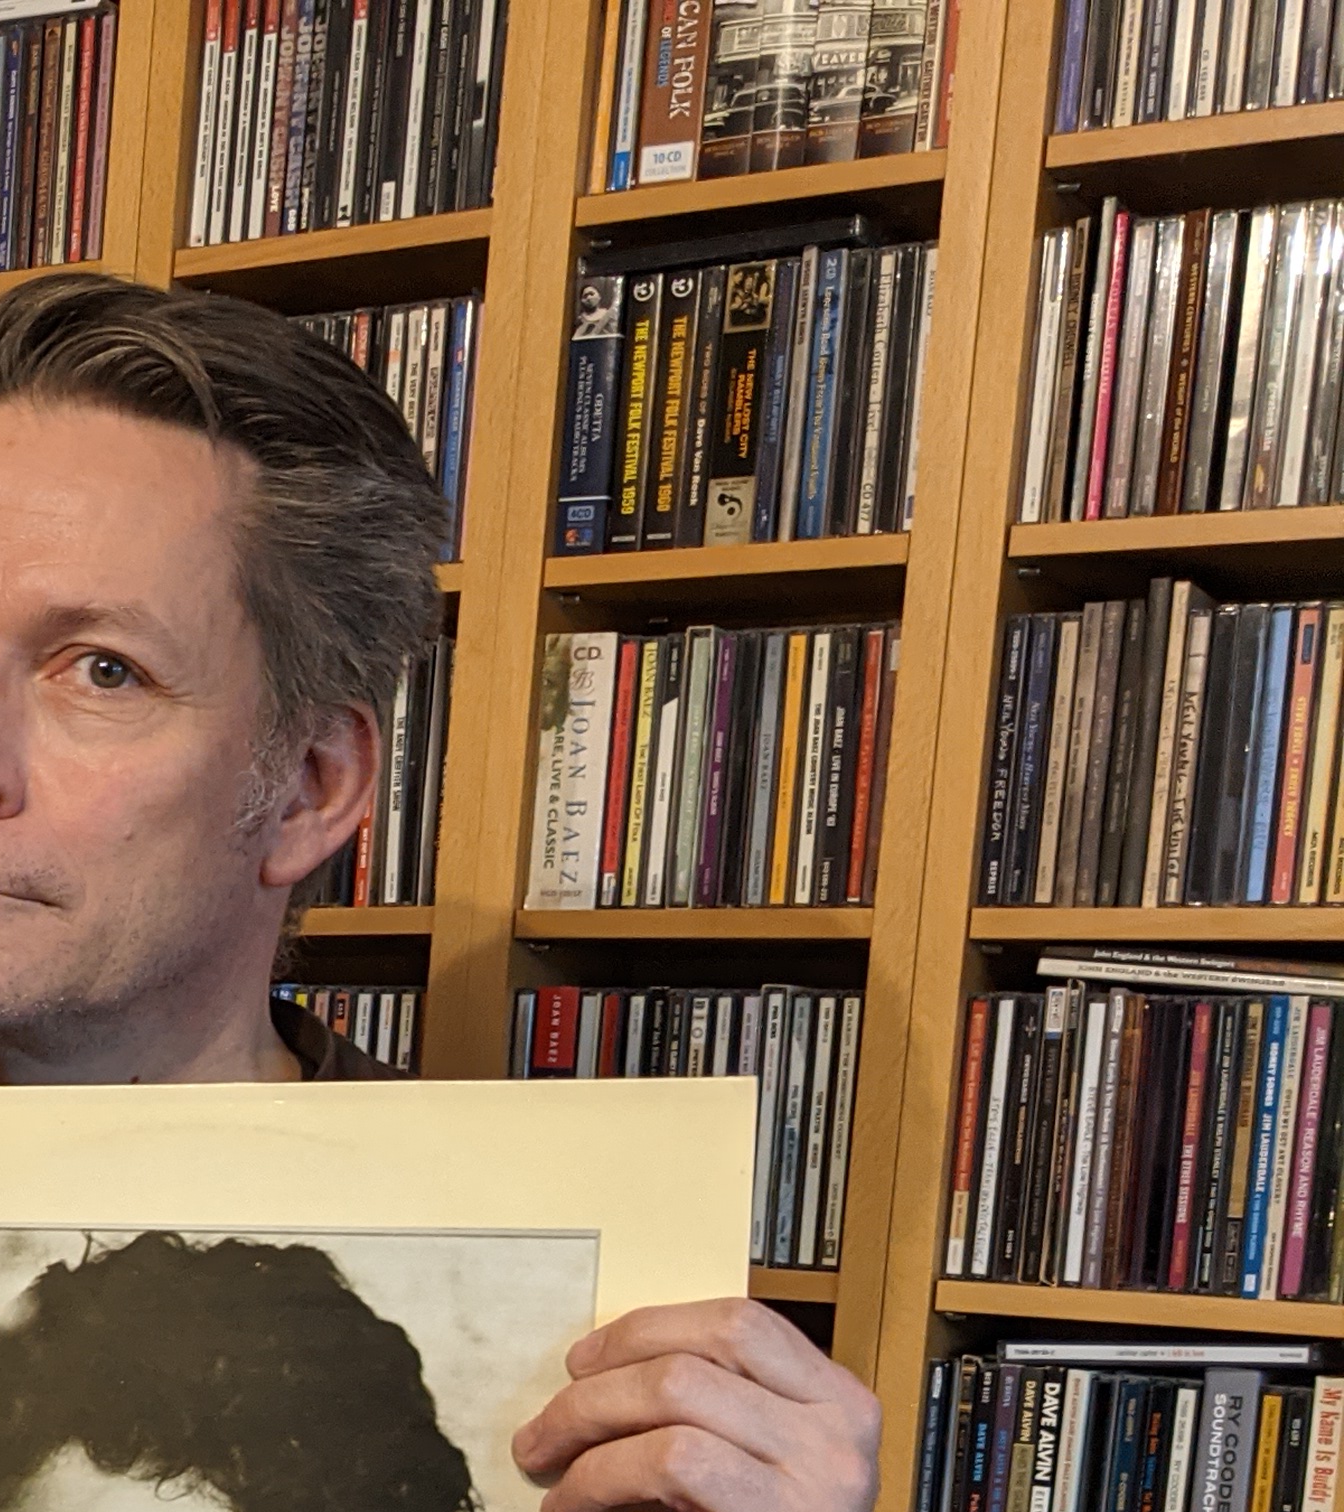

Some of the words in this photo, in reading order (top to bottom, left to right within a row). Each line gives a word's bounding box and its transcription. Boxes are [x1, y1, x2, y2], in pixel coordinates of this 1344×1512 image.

[273, 26, 296, 122] JOHNNY
[291, 16, 313, 127] JOHNNY
[669, 56, 696, 120] FOLK
[283, 134, 305, 208] CASH
[269, 185, 280, 213] LOVE
[287, 209, 297, 231] GOD
[1067, 272, 1081, 314] RODNEY
[1188, 263, 1201, 303] WESTERN
[875, 273, 893, 335] Elizabeth
[635, 319, 650, 342] THE
[672, 315, 688, 339] THE
[1181, 305, 1195, 353] CENTURIES
[667, 341, 687, 395] NEWPORT
[702, 343, 714, 368] TWO
[745, 349, 758, 371] THE
[870, 339, 888, 384] Cotten
[629, 345, 649, 399] NEWPORT
[742, 374, 754, 401] NEW
[591, 393, 605, 442] ODETTA
[626, 402, 644, 428] FOLK
[663, 400, 682, 427] FOLK
[732, 373, 746, 436] RAMBLERS
[740, 403, 753, 431] LOST
[865, 400, 882, 432] Live!
[694, 418, 707, 447] Dave
[737, 433, 748, 458] CITY
[1169, 431, 1181, 463] WORLD
[622, 432, 641, 482] FESTIVAL
[658, 430, 679, 480] FESTIVAL
[691, 451, 703, 473] Van
[619, 485, 637, 515] 1959
[688, 474, 702, 506] Ronk
[862, 483, 874, 500] CD
[644, 649, 657, 683] JOAN
[641, 686, 654, 719] BAEZ
[835, 707, 846, 727] JOAN
[568, 699, 596, 780] JOAN
[833, 728, 844, 749] BAEZ
[550, 759, 565, 791] LIVE
[830, 754, 842, 771] LIVE
[548, 794, 560, 804] &
[990, 767, 1008, 842] FREEDOM
[543, 808, 559, 869] CLASSIC
[805, 811, 817, 835] ALBUM
[559, 800, 587, 885] BAEZ
[987, 860, 999, 895] REPRISE
[1306, 851, 1318, 887] RECORDS
[551, 994, 561, 1027] JOAN
[771, 1005, 779, 1020] PHIL
[548, 1031, 559, 1063] BAEZ
[1314, 1026, 1326, 1046] JIM
[1222, 1054, 1232, 1068] JIM
[1085, 1086, 1097, 1112] STEVE
[1216, 1069, 1230, 1114] LAUDERDALE
[1305, 1048, 1324, 1119] LAUDERDALE
[813, 1107, 823, 1134] PAXTON
[1213, 1123, 1225, 1147] RALPH
[1261, 1112, 1273, 1131] JIM
[1181, 1144, 1195, 1159] THE
[1211, 1148, 1222, 1179] STANLEY
[1255, 1132, 1272, 1193] LAUDERDALE
[1299, 1127, 1315, 1171] REASON
[1079, 1164, 1090, 1182] Low
[1179, 1159, 1193, 1185] OTHER
[1296, 1173, 1310, 1197] AND
[1074, 1183, 1087, 1215] Highway
[1175, 1186, 1190, 1223] SESSIONS
[1291, 1199, 1306, 1239] RHYME
[1023, 1380, 1038, 1408] DAVE
[1040, 1382, 1062, 1428] DAVE
[1228, 1394, 1243, 1425] RY
[1317, 1388, 1343, 1406] My
[976, 1423, 989, 1450] DAVE
[1019, 1410, 1035, 1442] ALVIN
[973, 1451, 987, 1482] ALVIN
[1033, 1429, 1058, 1481] ALVIN
[1315, 1450, 1336, 1462] Is
[1167, 1473, 1181, 1511] COODER
[1308, 1467, 1334, 1503] Buddy
